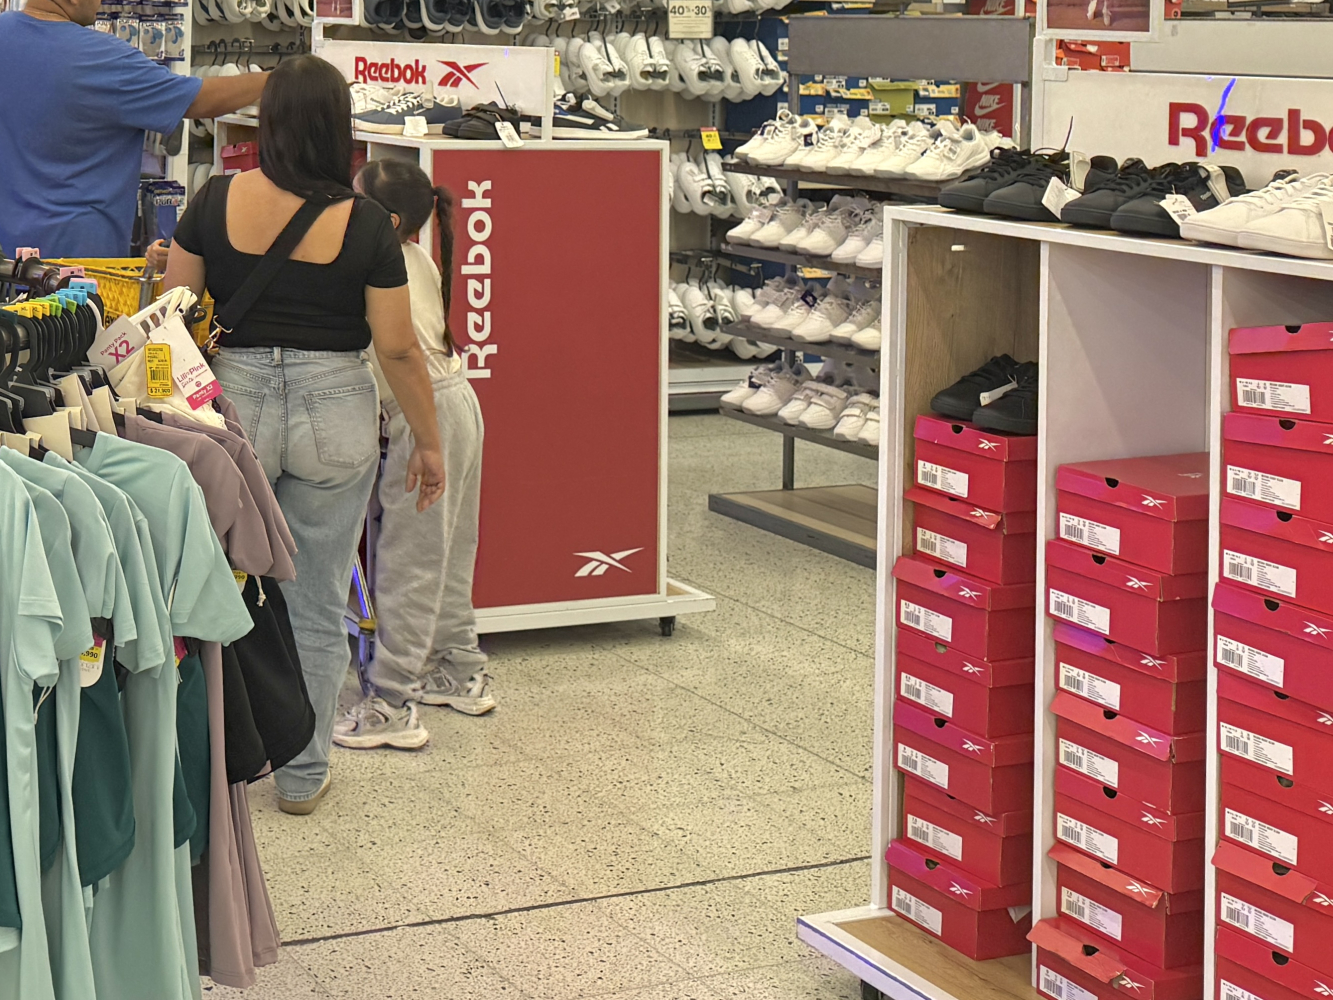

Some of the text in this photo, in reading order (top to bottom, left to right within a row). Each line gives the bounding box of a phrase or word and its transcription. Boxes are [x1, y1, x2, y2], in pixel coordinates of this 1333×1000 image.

[354, 56, 427, 85] Reebok
[979, 95, 1001, 107] NIKE
[1169, 102, 1333, 158] Reeb
[461, 179, 498, 379] Reebok
[100, 331, 128, 356] Panty Pack
[108, 339, 136, 365] X2
